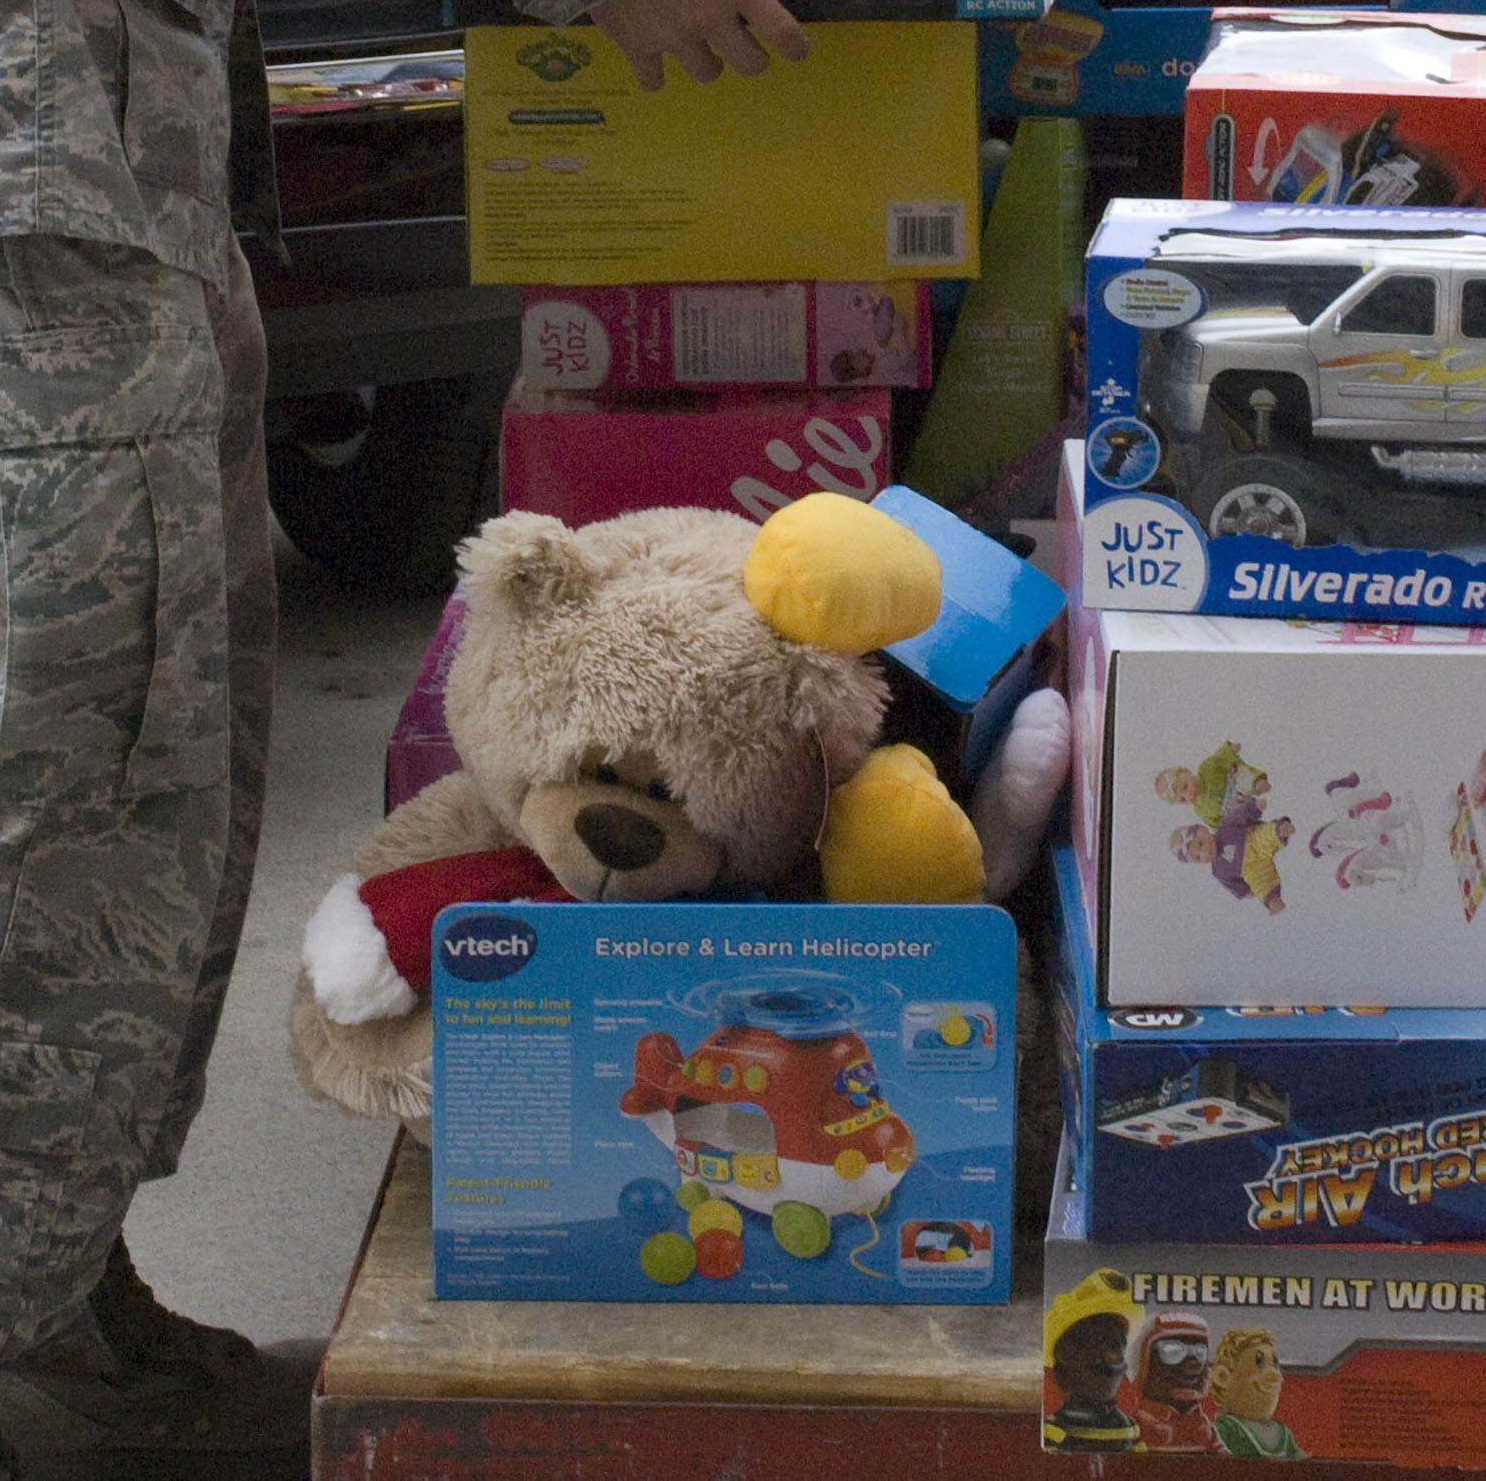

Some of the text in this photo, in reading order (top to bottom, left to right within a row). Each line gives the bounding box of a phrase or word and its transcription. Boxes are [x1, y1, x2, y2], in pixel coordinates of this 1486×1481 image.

[966, 0, 1036, 11] RC ACTION
[539, 320, 562, 376] JUST
[567, 320, 588, 374] KIDZ
[1101, 521, 1183, 553] JUST
[1107, 555, 1182, 590] KIDZ
[1228, 562, 1453, 607] Silverado
[444, 935, 529, 956] vtech
[595, 937, 932, 960] Explore & Learn Helicopter
[446, 997, 571, 1012] The sky's the limit
[446, 1014, 459, 1024] to
[462, 1013, 484, 1024] fun
[488, 1013, 511, 1025] and
[1269, 1122, 1424, 1177] HOCKEY
[1249, 1167, 1378, 1230] AIR
[1133, 1274, 1312, 1307] FIREMEN
[1322, 1278, 1374, 1310] AT
